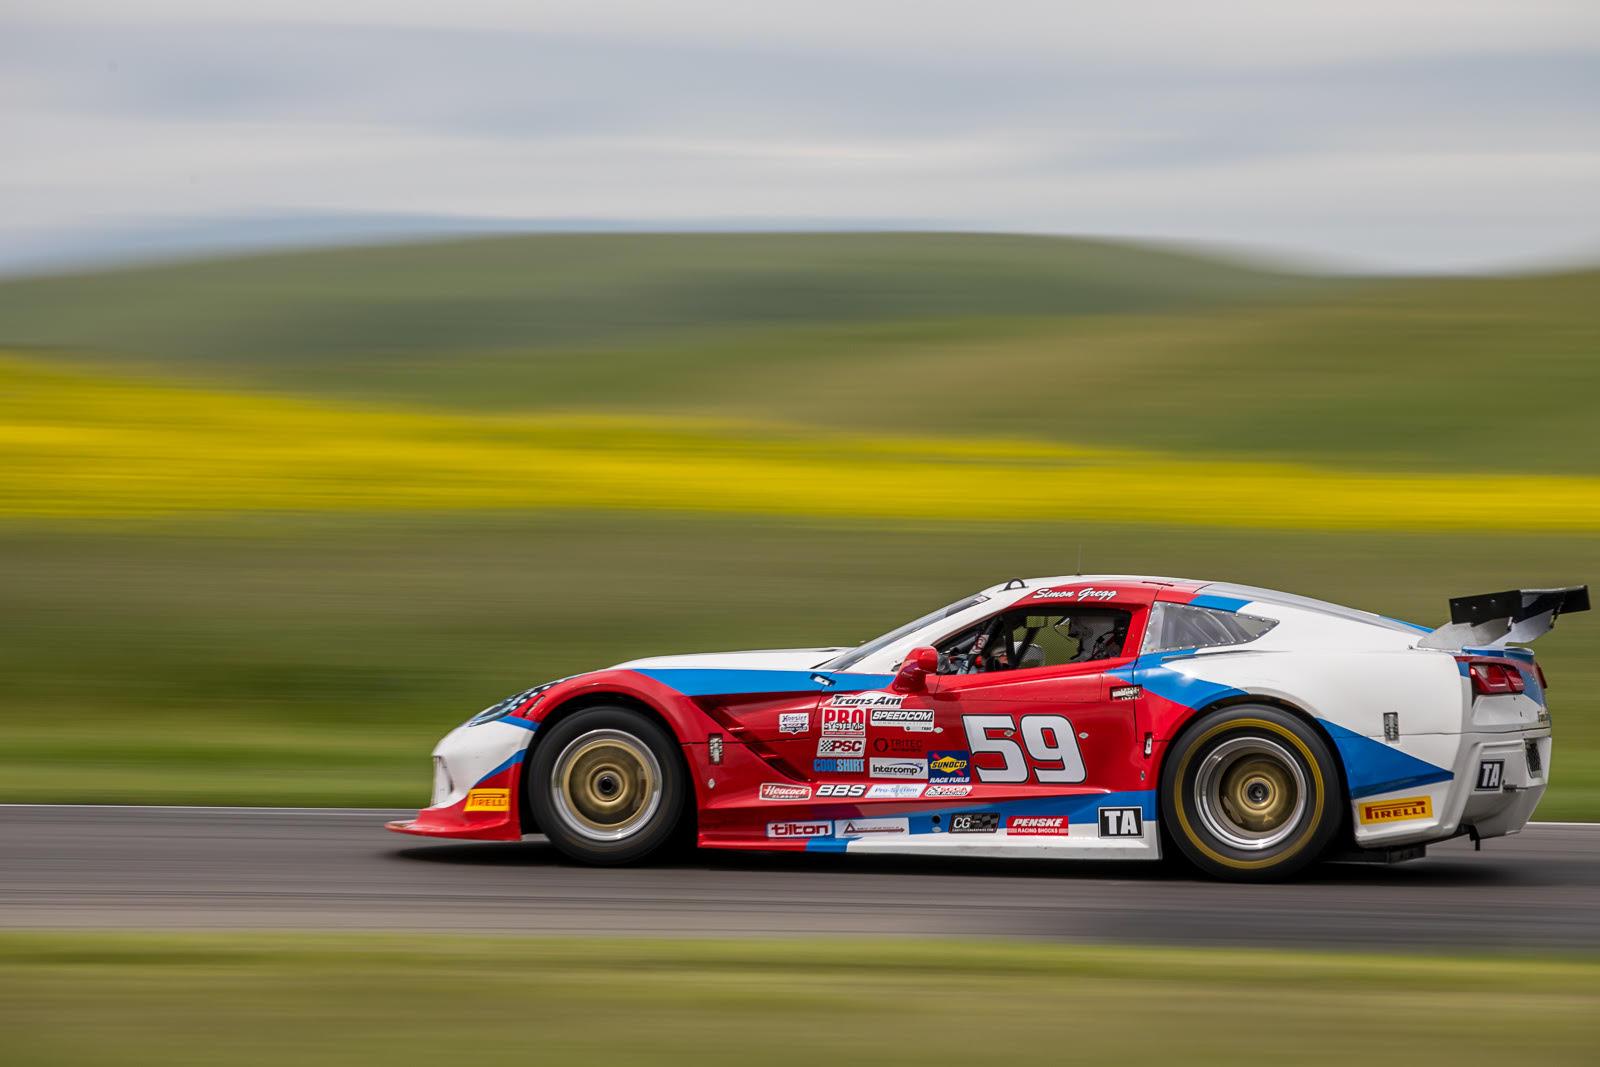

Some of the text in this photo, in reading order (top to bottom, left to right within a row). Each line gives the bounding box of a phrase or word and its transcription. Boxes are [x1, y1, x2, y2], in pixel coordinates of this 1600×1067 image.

[1033, 587, 1117, 602] Simon Gregg
[832, 695, 902, 706] Trans Am
[824, 709, 865, 724] PRO
[823, 722, 865, 731] SYSTEMS
[831, 740, 863, 752] PSC
[961, 714, 1087, 784] 59
[872, 764, 918, 776] Intercomp
[932, 761, 966, 769] SUNOCO
[1482, 763, 1501, 787] TA
[763, 785, 809, 797] Heacock
[815, 784, 866, 797] BBS
[1365, 801, 1426, 819] PIRELLI
[953, 817, 971, 829] CG
[1013, 818, 1064, 827] PENSKE
[1104, 810, 1139, 834] TA
[771, 824, 829, 836] tilton
